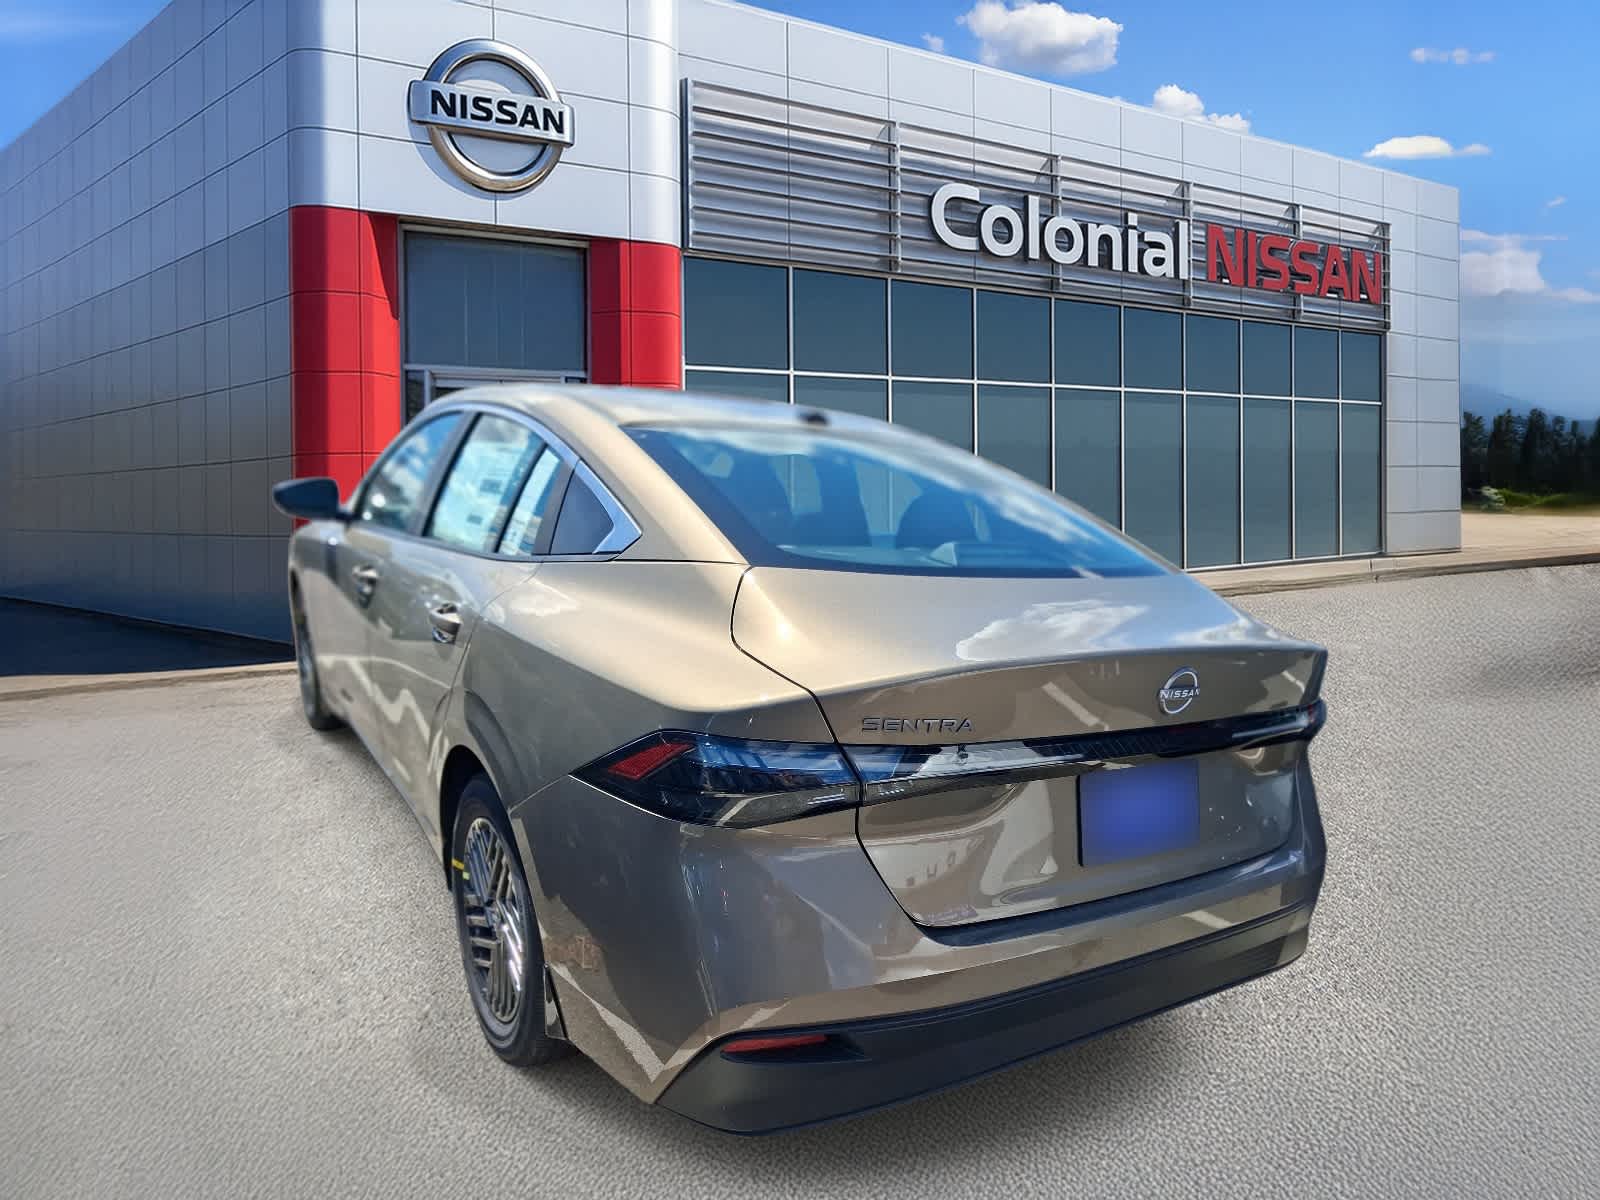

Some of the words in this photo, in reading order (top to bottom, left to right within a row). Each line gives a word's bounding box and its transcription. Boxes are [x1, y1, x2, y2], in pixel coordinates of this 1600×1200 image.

[430, 89, 565, 134] NISSAN
[931, 183, 1189, 280] Colonial
[1206, 223, 1382, 304] NISSAN
[1160, 688, 1200, 699] NISSAN
[861, 716, 975, 734] SENTRA
